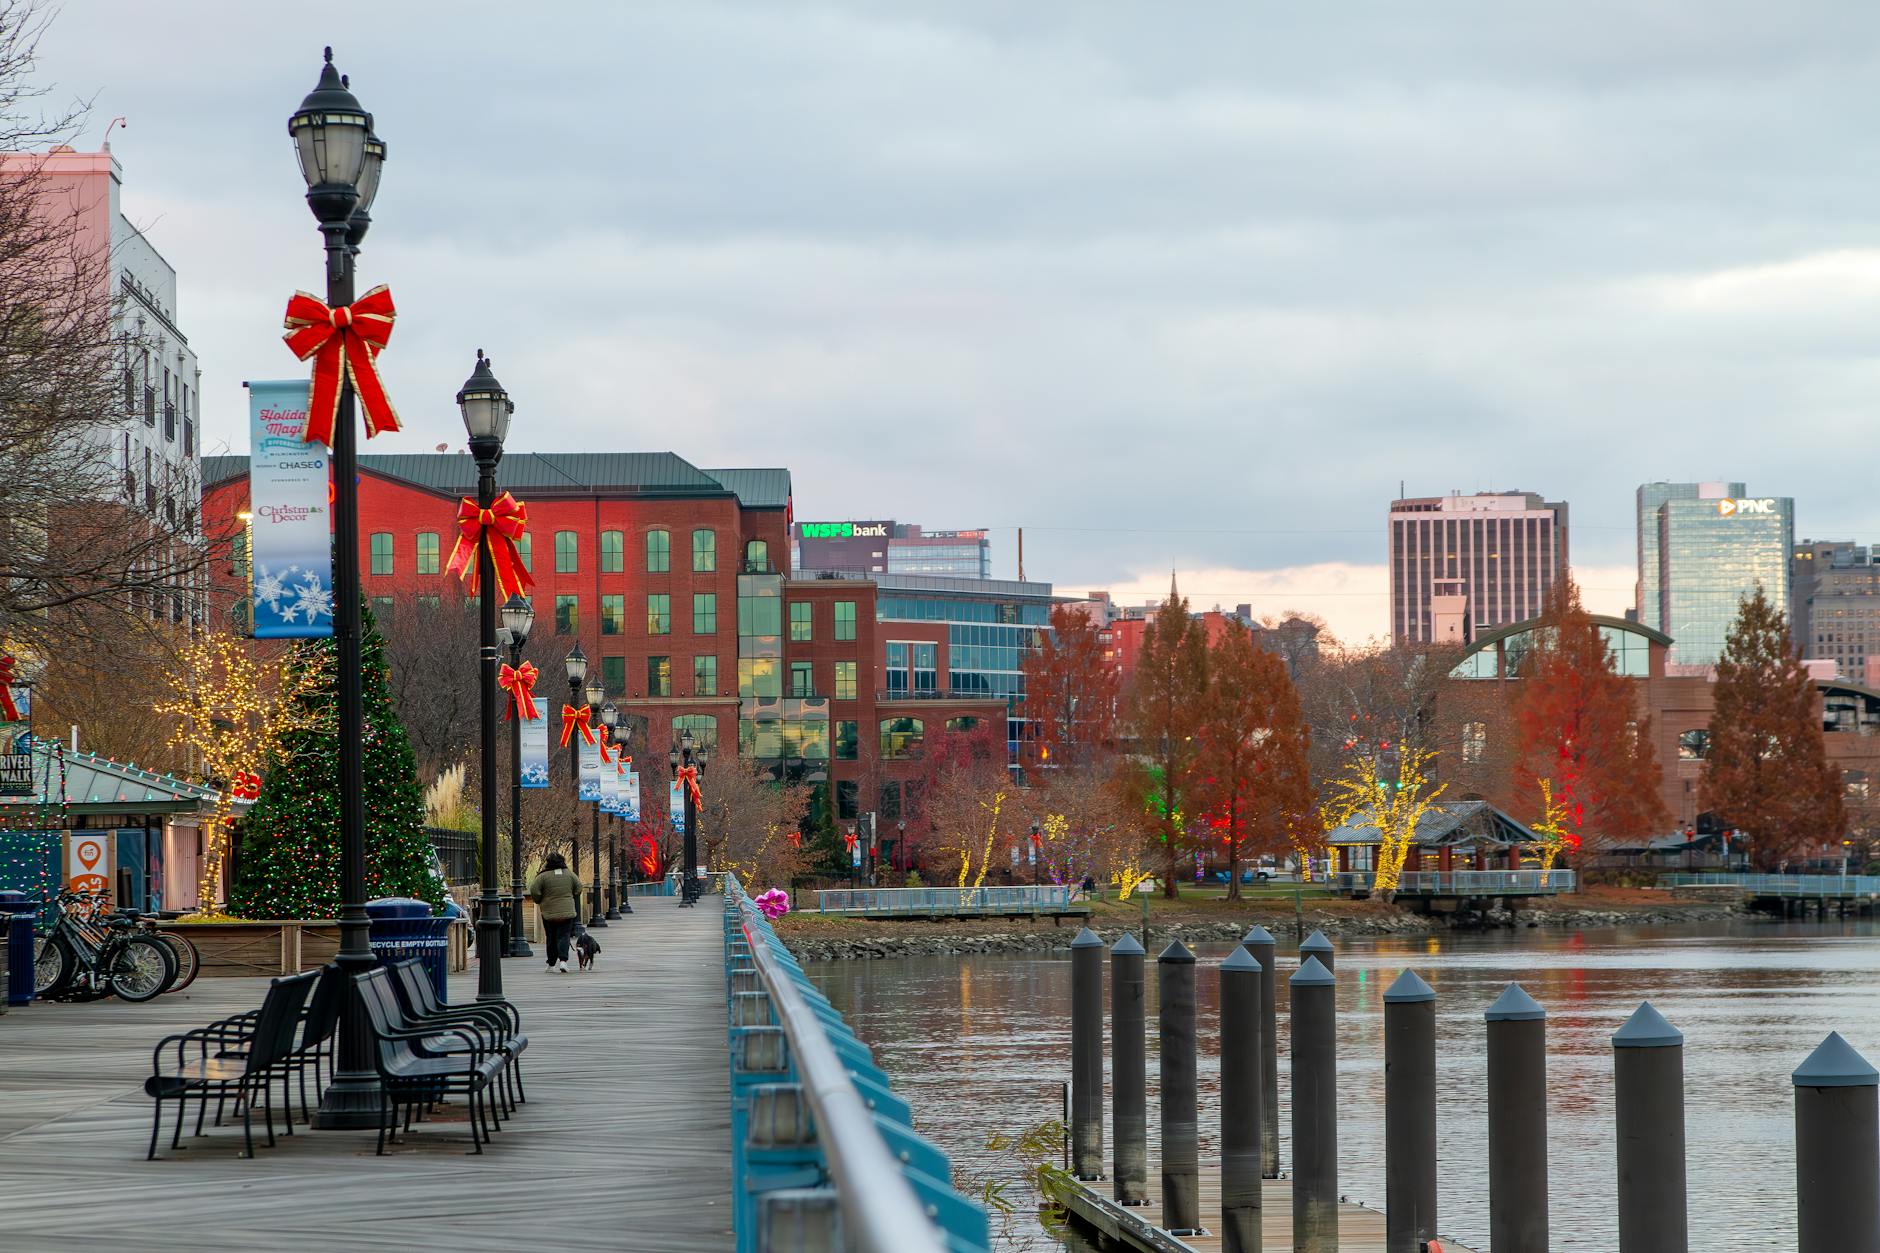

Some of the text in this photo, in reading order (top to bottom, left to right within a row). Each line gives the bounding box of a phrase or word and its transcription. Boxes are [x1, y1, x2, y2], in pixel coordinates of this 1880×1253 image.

[260, 409, 307, 421] Holida
[266, 422, 304, 437] Magi
[279, 461, 313, 469] CHASE
[1737, 499, 1776, 514] PNC
[272, 513, 308, 523] Decor
[801, 523, 887, 538] WSFS bank
[0, 770, 31, 782] WALK
[401, 940, 425, 948] EMPTY
